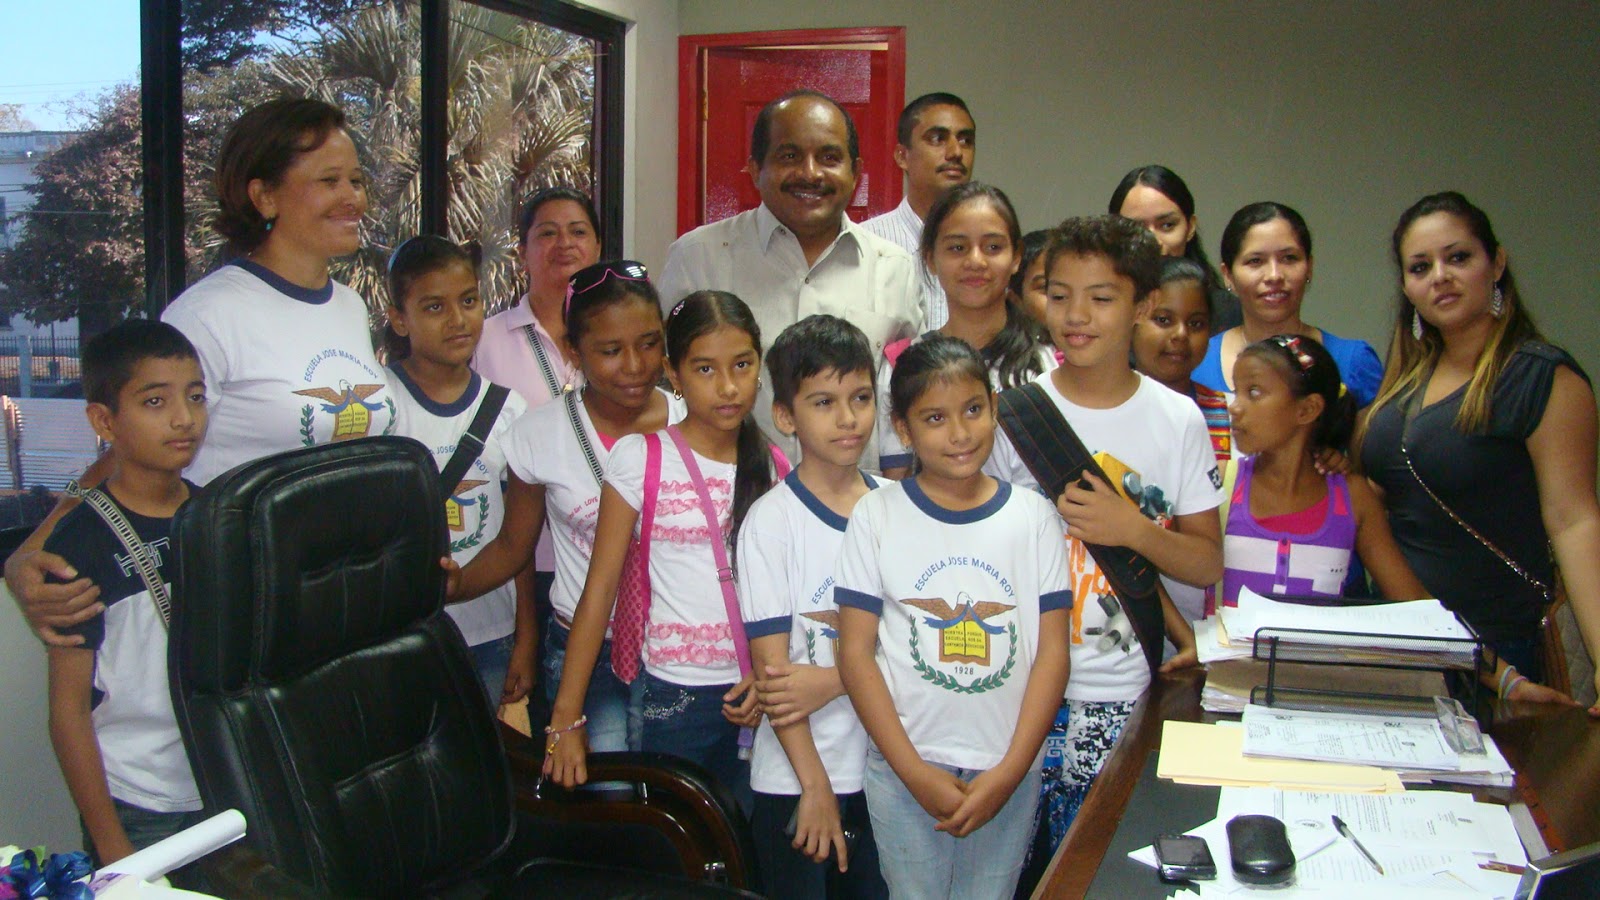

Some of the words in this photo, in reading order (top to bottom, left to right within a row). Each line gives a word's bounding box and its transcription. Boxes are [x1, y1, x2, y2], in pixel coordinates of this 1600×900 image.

[304, 354, 323, 382] ESCUELA
[322, 348, 337, 359] JOSE
[338, 350, 362, 367] MARIA
[363, 364, 378, 379] ROY
[436, 445, 454, 455] JOSE
[475, 459, 489, 475] ROY
[584, 496, 598, 506] LOVE
[811, 576, 835, 605] ESCUEL
[914, 560, 947, 592] ESCUELA
[948, 556, 968, 566] JOSE
[971, 558, 1000, 580] MARIA
[999, 577, 1015, 597] ROY
[954, 666, 974, 675] 1928
